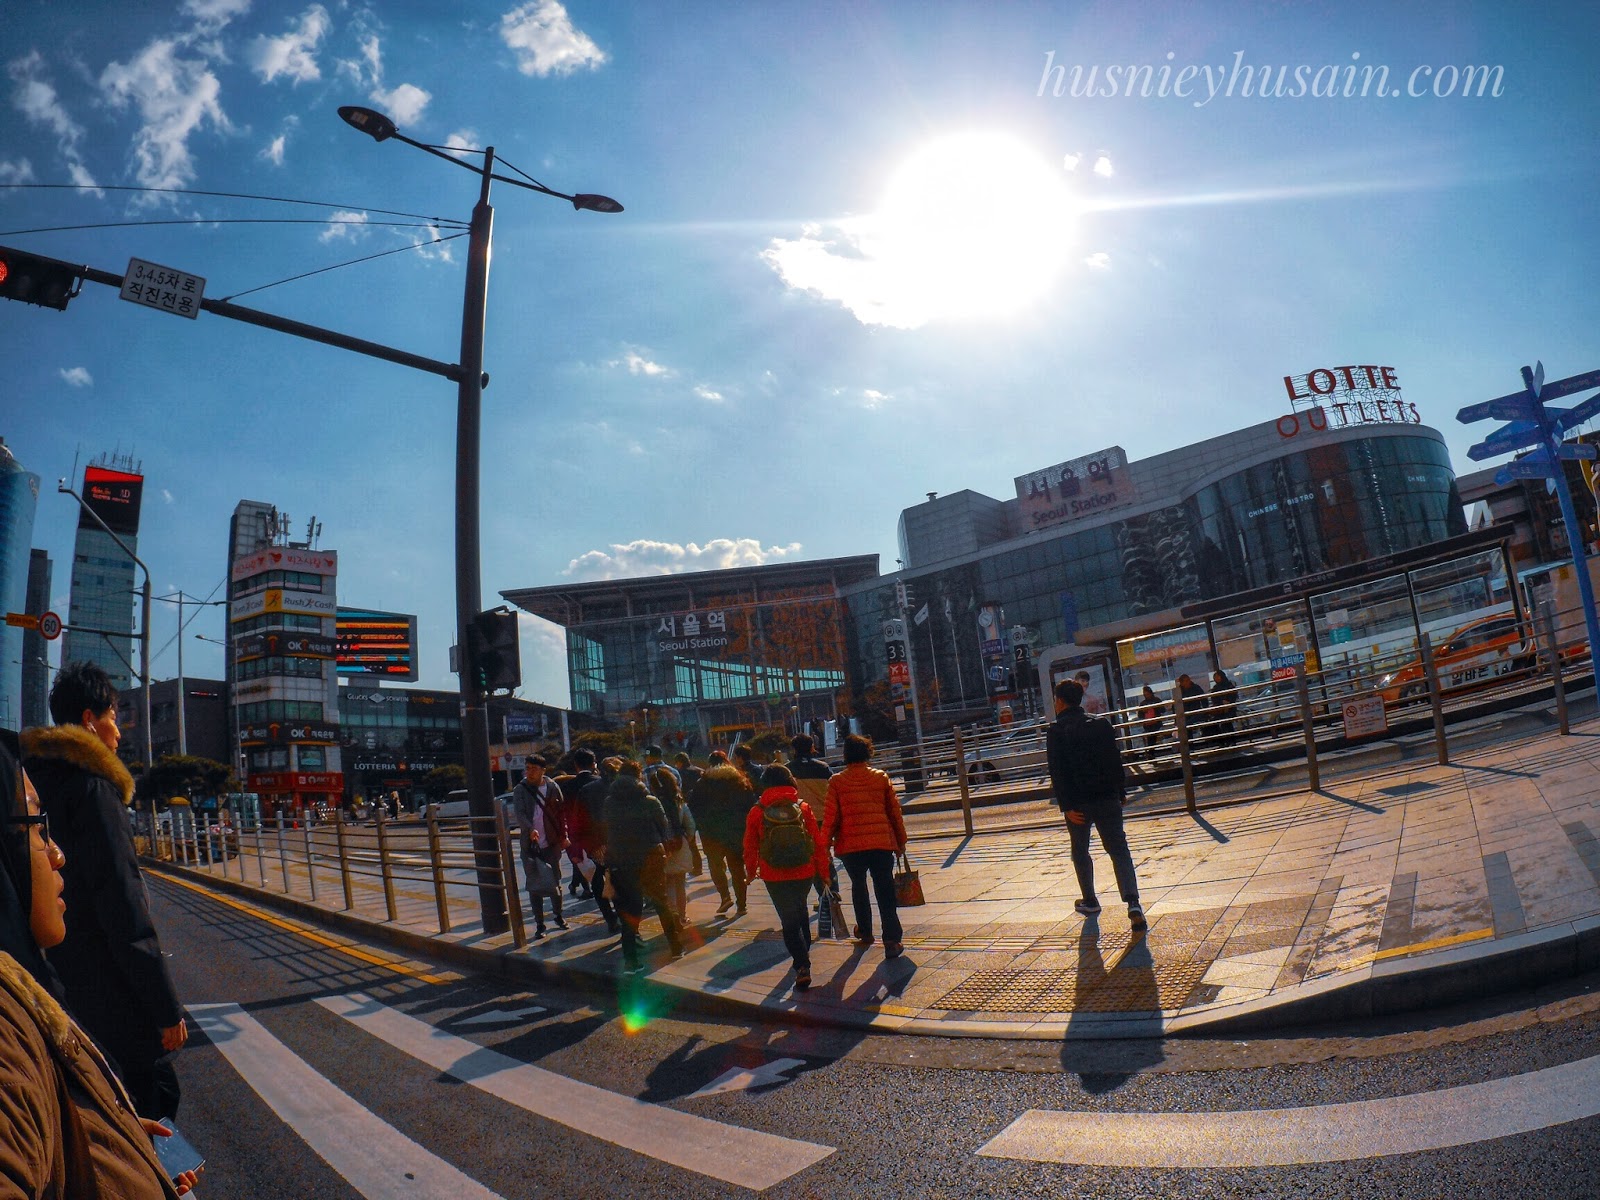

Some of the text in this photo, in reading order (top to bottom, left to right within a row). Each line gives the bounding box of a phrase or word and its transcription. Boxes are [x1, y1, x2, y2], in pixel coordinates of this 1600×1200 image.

[129, 282, 193, 313] 직진전용
[1283, 365, 1401, 400] LOTTE
[1276, 400, 1421, 438] OUTLETS
[1028, 457, 1113, 502] 서울역
[1032, 492, 1117, 525] Seoul Station
[1248, 492, 1315, 518] CHINESE BISTRO
[284, 597, 334, 610] Rush Cash
[44, 619, 57, 632] 60
[657, 610, 727, 637] 서울역
[287, 640, 302, 650] OK
[659, 637, 728, 652] Seoul Station
[888, 645, 897, 660] 3
[1016, 648, 1024, 659] 2
[290, 728, 306, 739] OK
[353, 762, 397, 771] LOTTERIA
